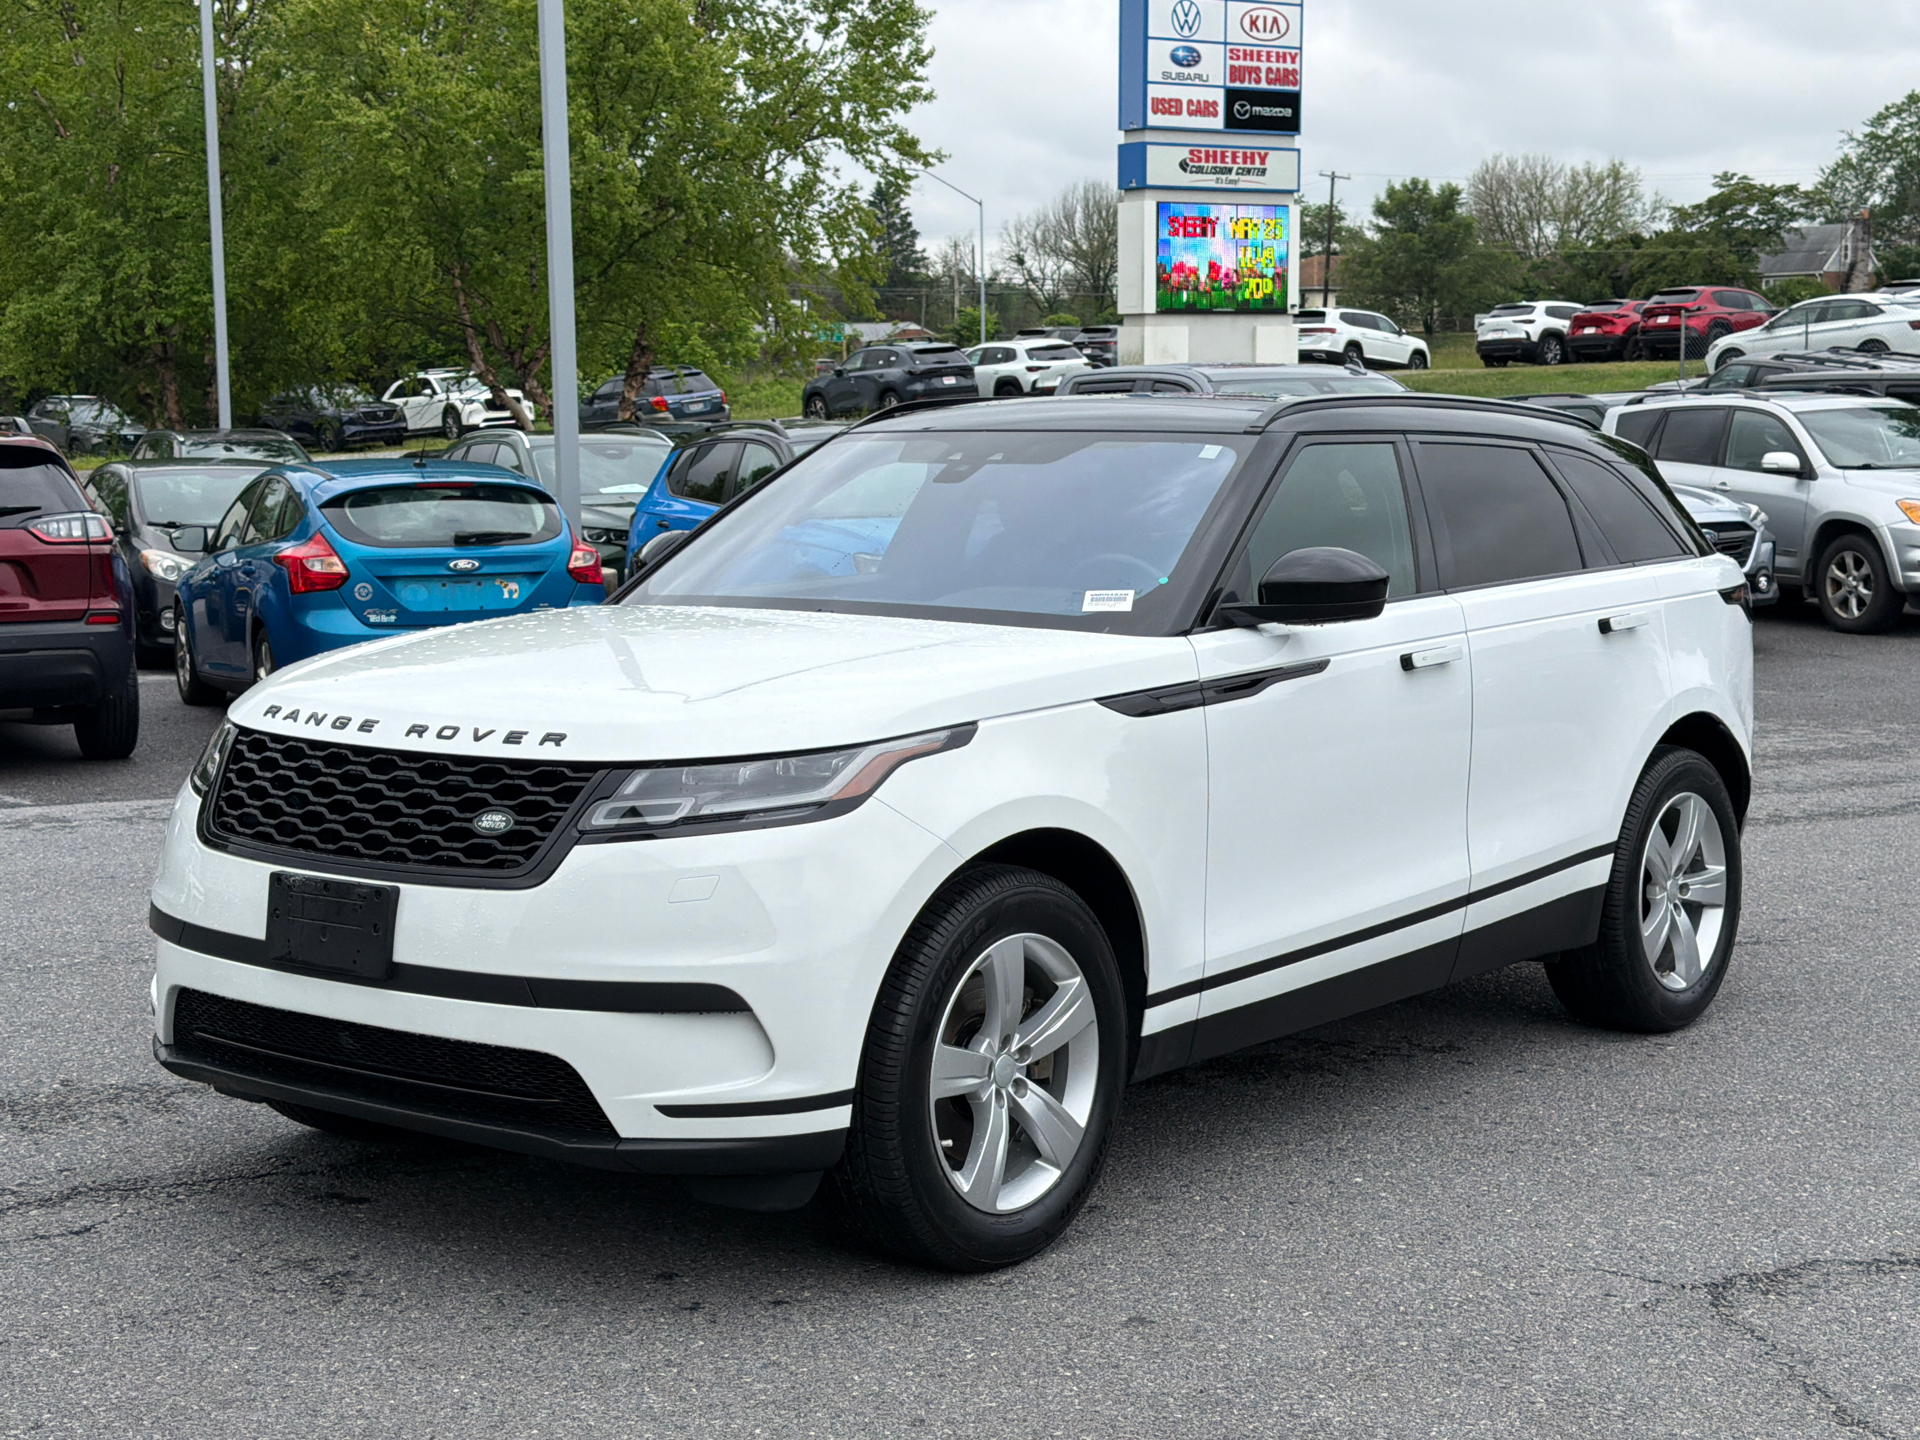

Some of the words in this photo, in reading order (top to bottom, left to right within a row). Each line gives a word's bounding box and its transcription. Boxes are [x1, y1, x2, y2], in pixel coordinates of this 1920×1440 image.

[1249, 14, 1281, 34] KIA
[1229, 48, 1299, 65] SHEEHY
[1161, 71, 1209, 83] SUBARU
[1229, 65, 1262, 85] BUYS
[1265, 67, 1299, 87] CARS
[1151, 97, 1183, 116] USED
[1187, 99, 1218, 118] CARS
[1188, 149, 1269, 166] SHEEHY
[1189, 165, 1234, 176] COLLISION
[1235, 166, 1267, 177] CENTER
[1215, 176, 1224, 184] It's
[1225, 177, 1240, 186] Easy!
[1168, 216, 1218, 237] SHEEHY
[1230, 217, 1261, 239] MAY
[1264, 218, 1283, 239] 25
[263, 704, 380, 733] RANGE
[404, 723, 568, 747] ROVER
